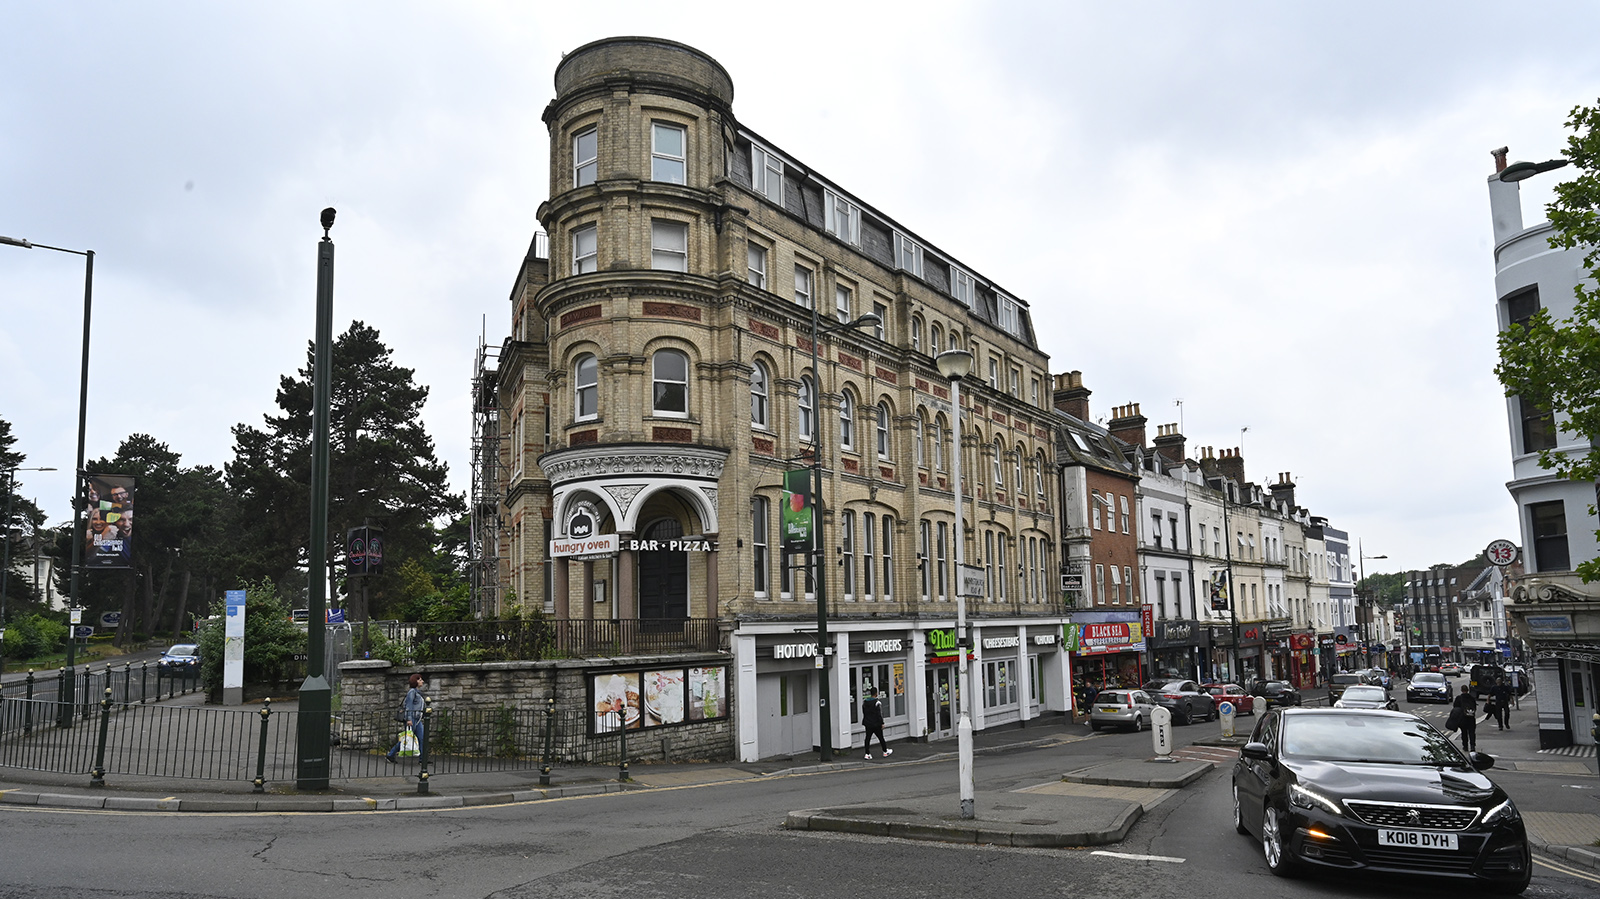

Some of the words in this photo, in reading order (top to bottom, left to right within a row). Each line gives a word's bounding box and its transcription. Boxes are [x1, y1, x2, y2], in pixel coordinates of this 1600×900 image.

[553, 541, 585, 553] hungry
[587, 540, 610, 550] oven
[630, 540, 659, 551] BAR
[669, 540, 711, 552] PIZZA
[1493, 548, 1511, 559] 13
[1092, 625, 1111, 638] BLACK
[1112, 624, 1123, 637] SEA
[864, 639, 902, 653] BURGERS
[983, 636, 1020, 649] CHEESESTEAKS
[774, 643, 796, 659] HOT
[1386, 831, 1418, 845] KO18
[1421, 833, 1449, 847] DYH
